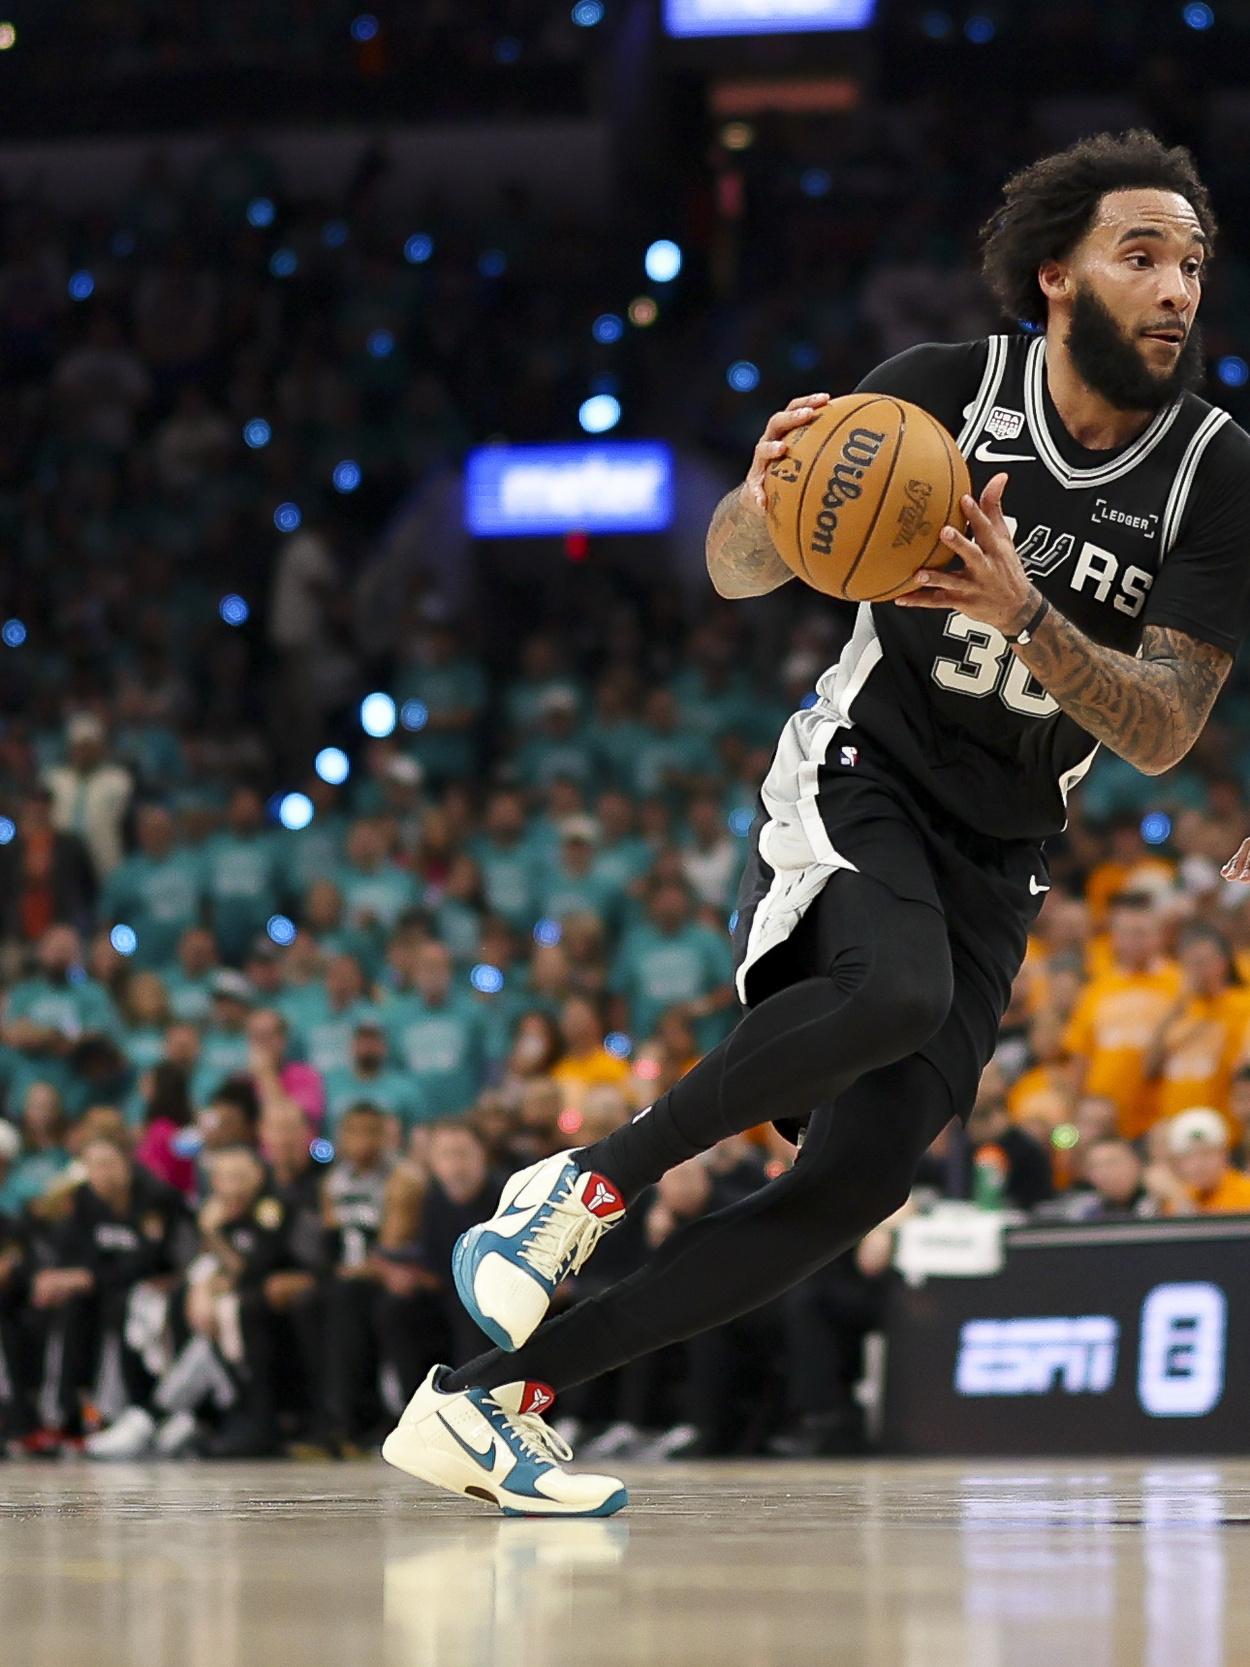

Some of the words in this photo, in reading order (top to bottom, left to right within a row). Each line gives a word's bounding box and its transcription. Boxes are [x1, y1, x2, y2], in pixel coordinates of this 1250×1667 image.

[810, 427, 887, 555] Wilson
[1101, 507, 1150, 531] LEDGER
[955, 1315, 1121, 1398] ESPN
